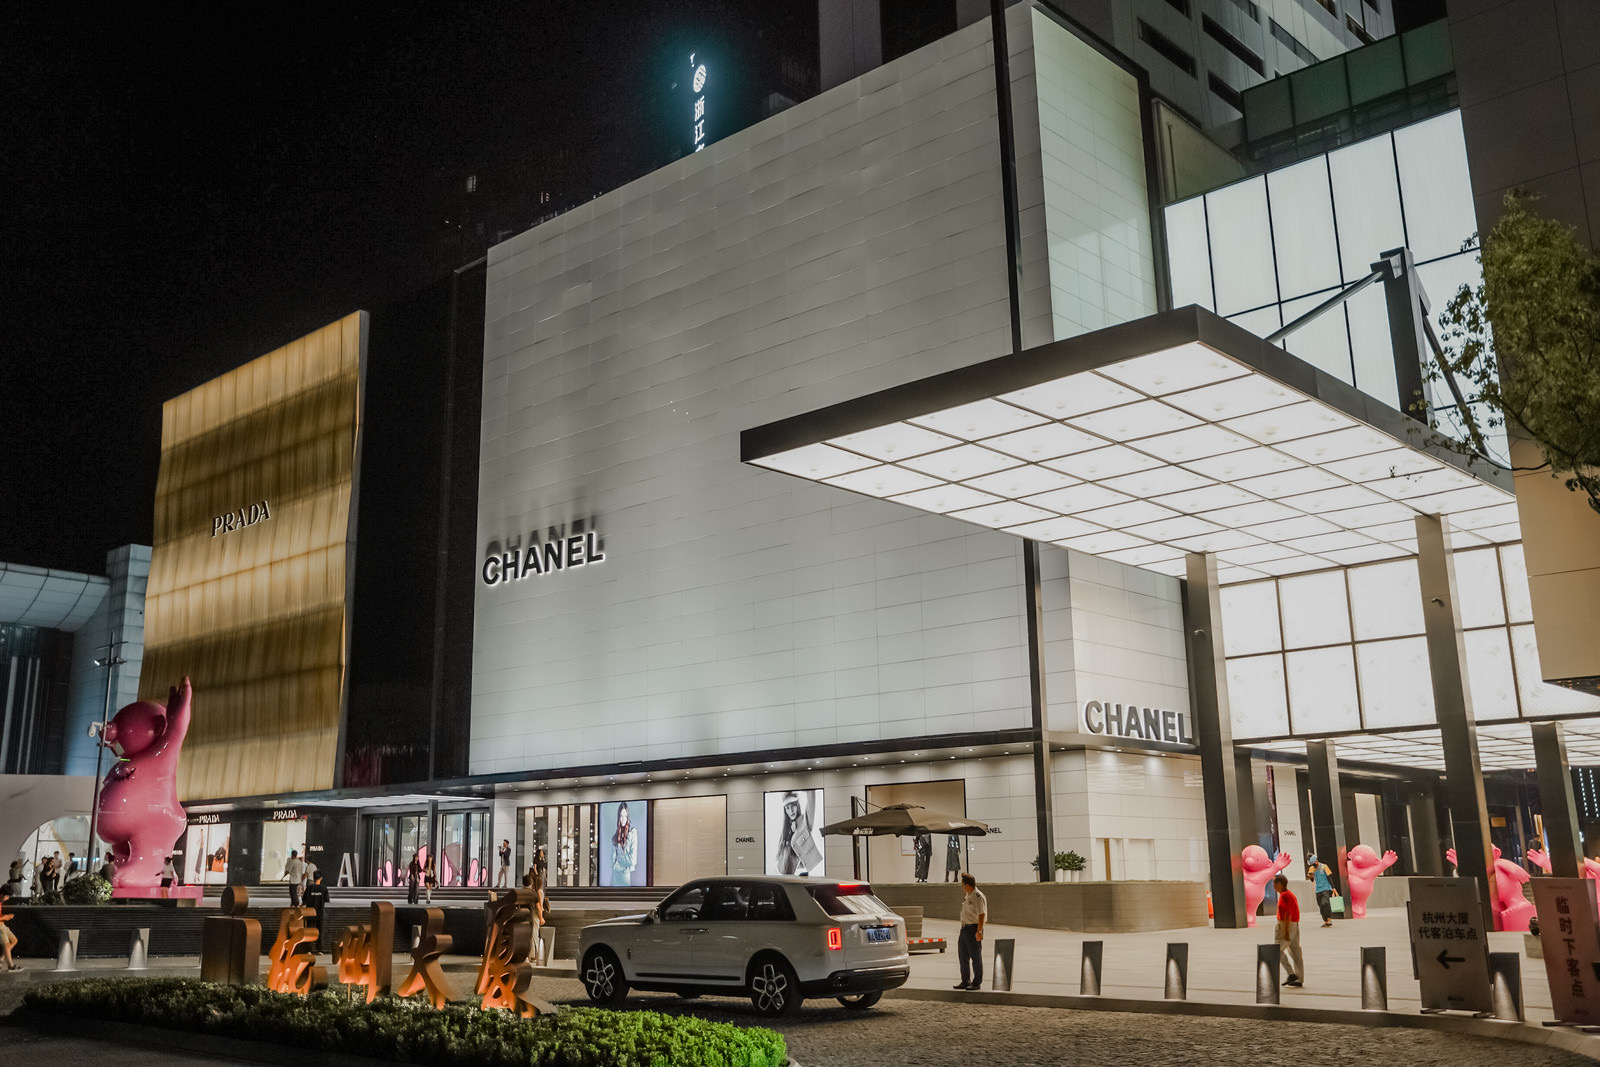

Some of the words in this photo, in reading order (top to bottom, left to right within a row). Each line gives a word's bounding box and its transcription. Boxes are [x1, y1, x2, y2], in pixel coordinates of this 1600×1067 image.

[211, 500, 271, 538] PRADA
[482, 531, 605, 586] CHANEL
[1085, 700, 1192, 743] CHANEL
[199, 814, 220, 824] PRADA
[273, 809, 297, 820] PRADA
[1422, 912, 1469, 925] 杭州大厦
[1418, 926, 1478, 940] 代客泊车点
[1555, 895, 1586, 999] 临时下客点
